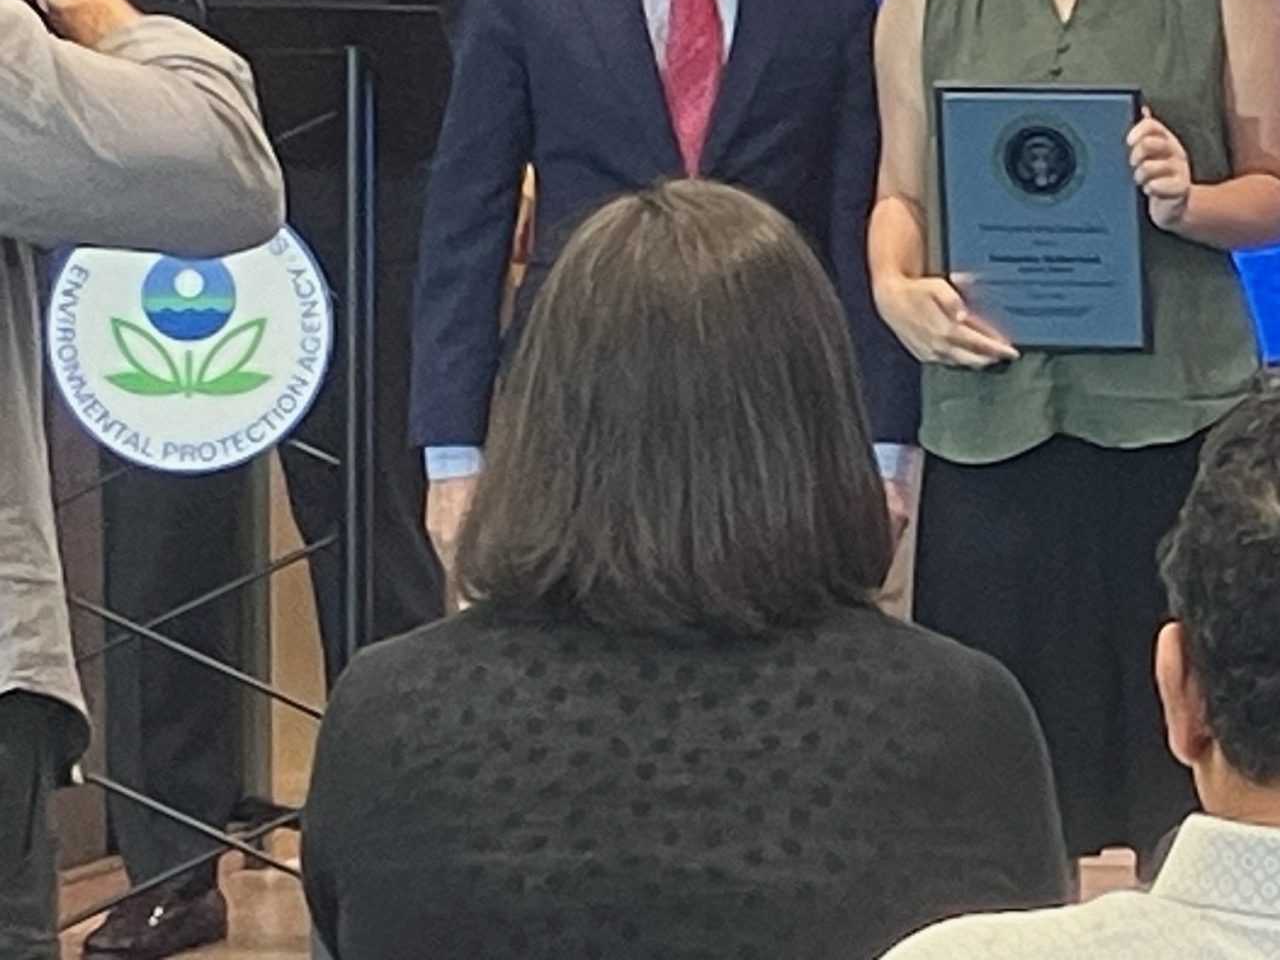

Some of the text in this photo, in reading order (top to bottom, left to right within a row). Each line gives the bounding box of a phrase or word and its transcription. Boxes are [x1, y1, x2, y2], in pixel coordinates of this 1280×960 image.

[55, 263, 322, 462] ENVIRONMENTAL PROTECTION AGENCY
